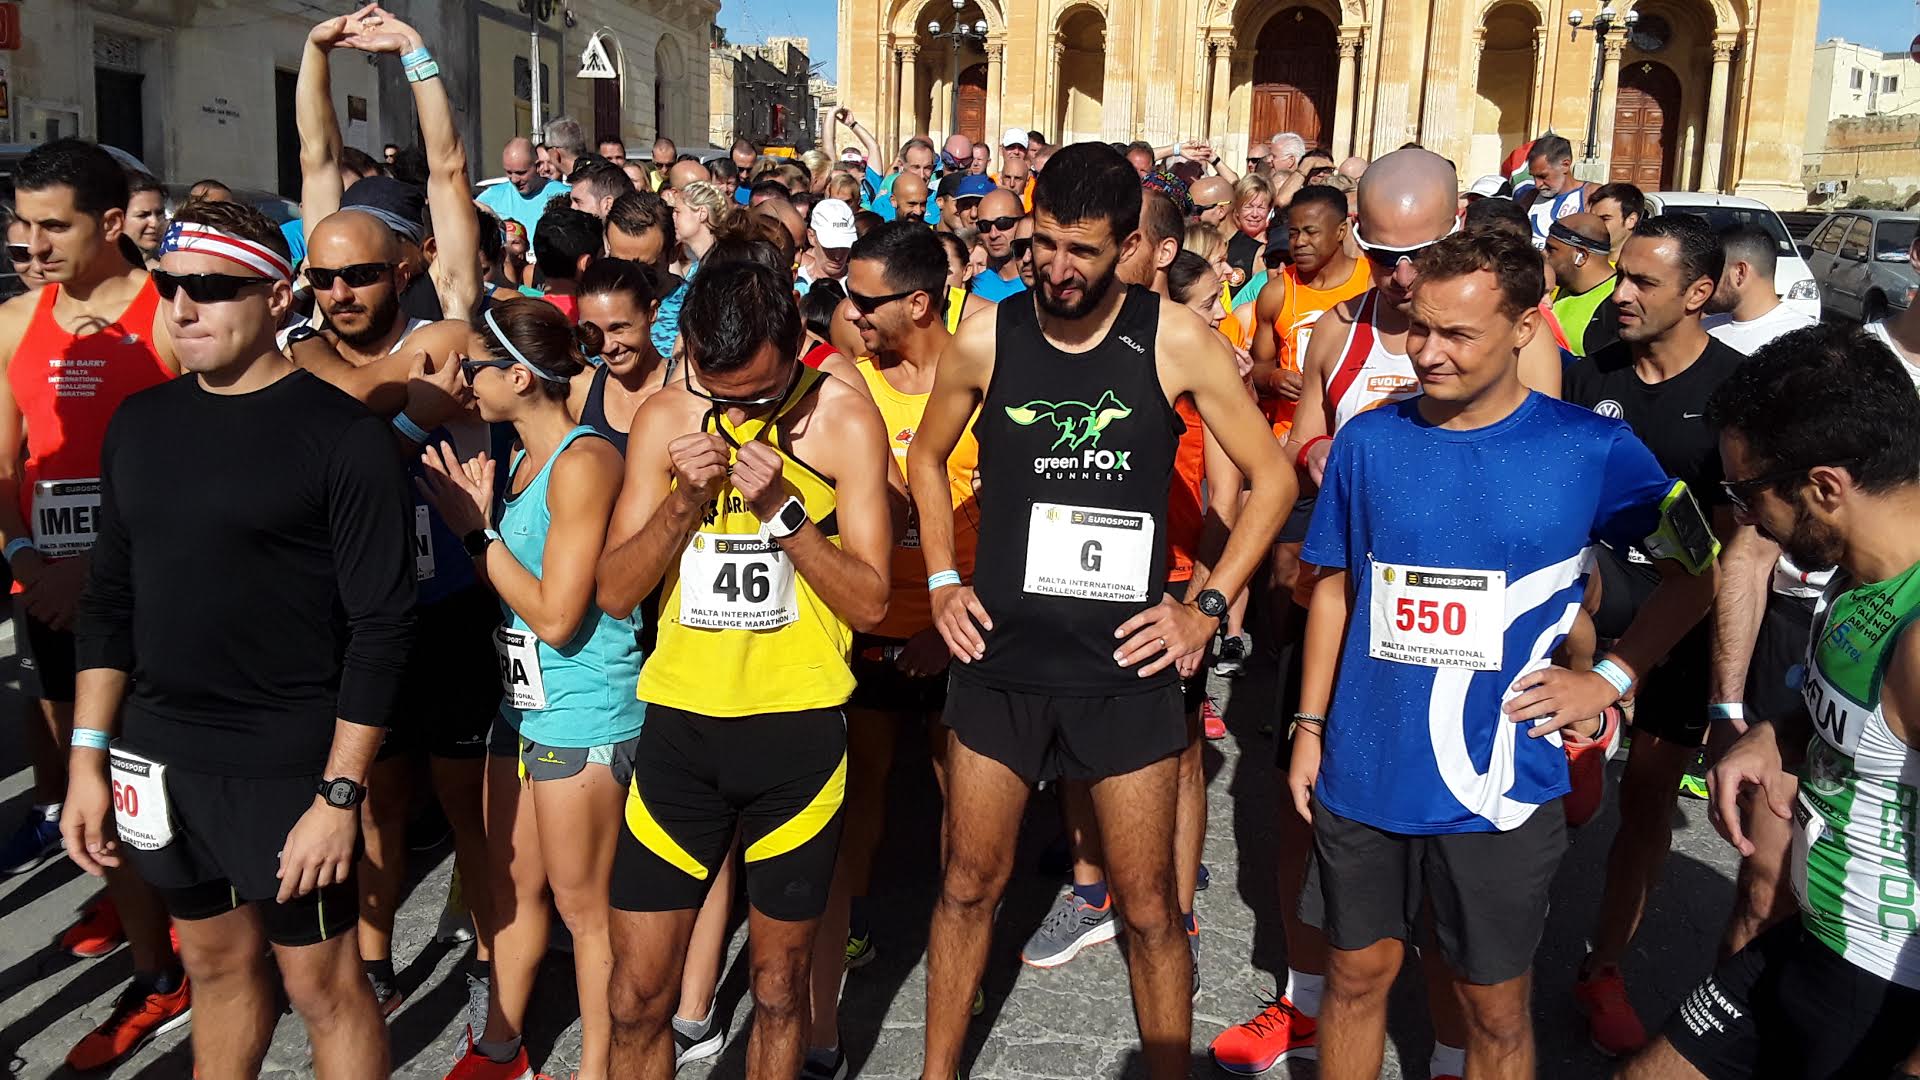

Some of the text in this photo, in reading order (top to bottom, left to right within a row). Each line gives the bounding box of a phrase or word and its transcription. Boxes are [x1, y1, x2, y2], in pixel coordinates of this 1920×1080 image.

[49, 359, 106, 367] TEAM BARRY
[1370, 377, 1416, 388] EVOLVE
[1034, 449, 1132, 474] green FOX
[1046, 472, 1124, 481] RUNNERS
[65, 485, 101, 493] EUROSPO
[1087, 516, 1140, 527] EUROSPORT
[1080, 539, 1103, 572] G
[712, 562, 770, 603] 46
[1038, 576, 1136, 592] MALTA INTERNATIONAL
[1422, 576, 1485, 588] EUROSPORT
[1036, 585, 1136, 600] CHALLENGE MARATHON
[690, 606, 788, 618] MALTA INTERNATIONAL
[1395, 597, 1467, 636] 550
[690, 614, 789, 628] CHALLENGE MARATHON
[1380, 640, 1486, 659] MALTA INTERNATIONAL
[1379, 650, 1487, 669] CHALLENGE MARATHON
[1698, 984, 1713, 1008] ALTA
[1708, 983, 1743, 1019] BARRY
